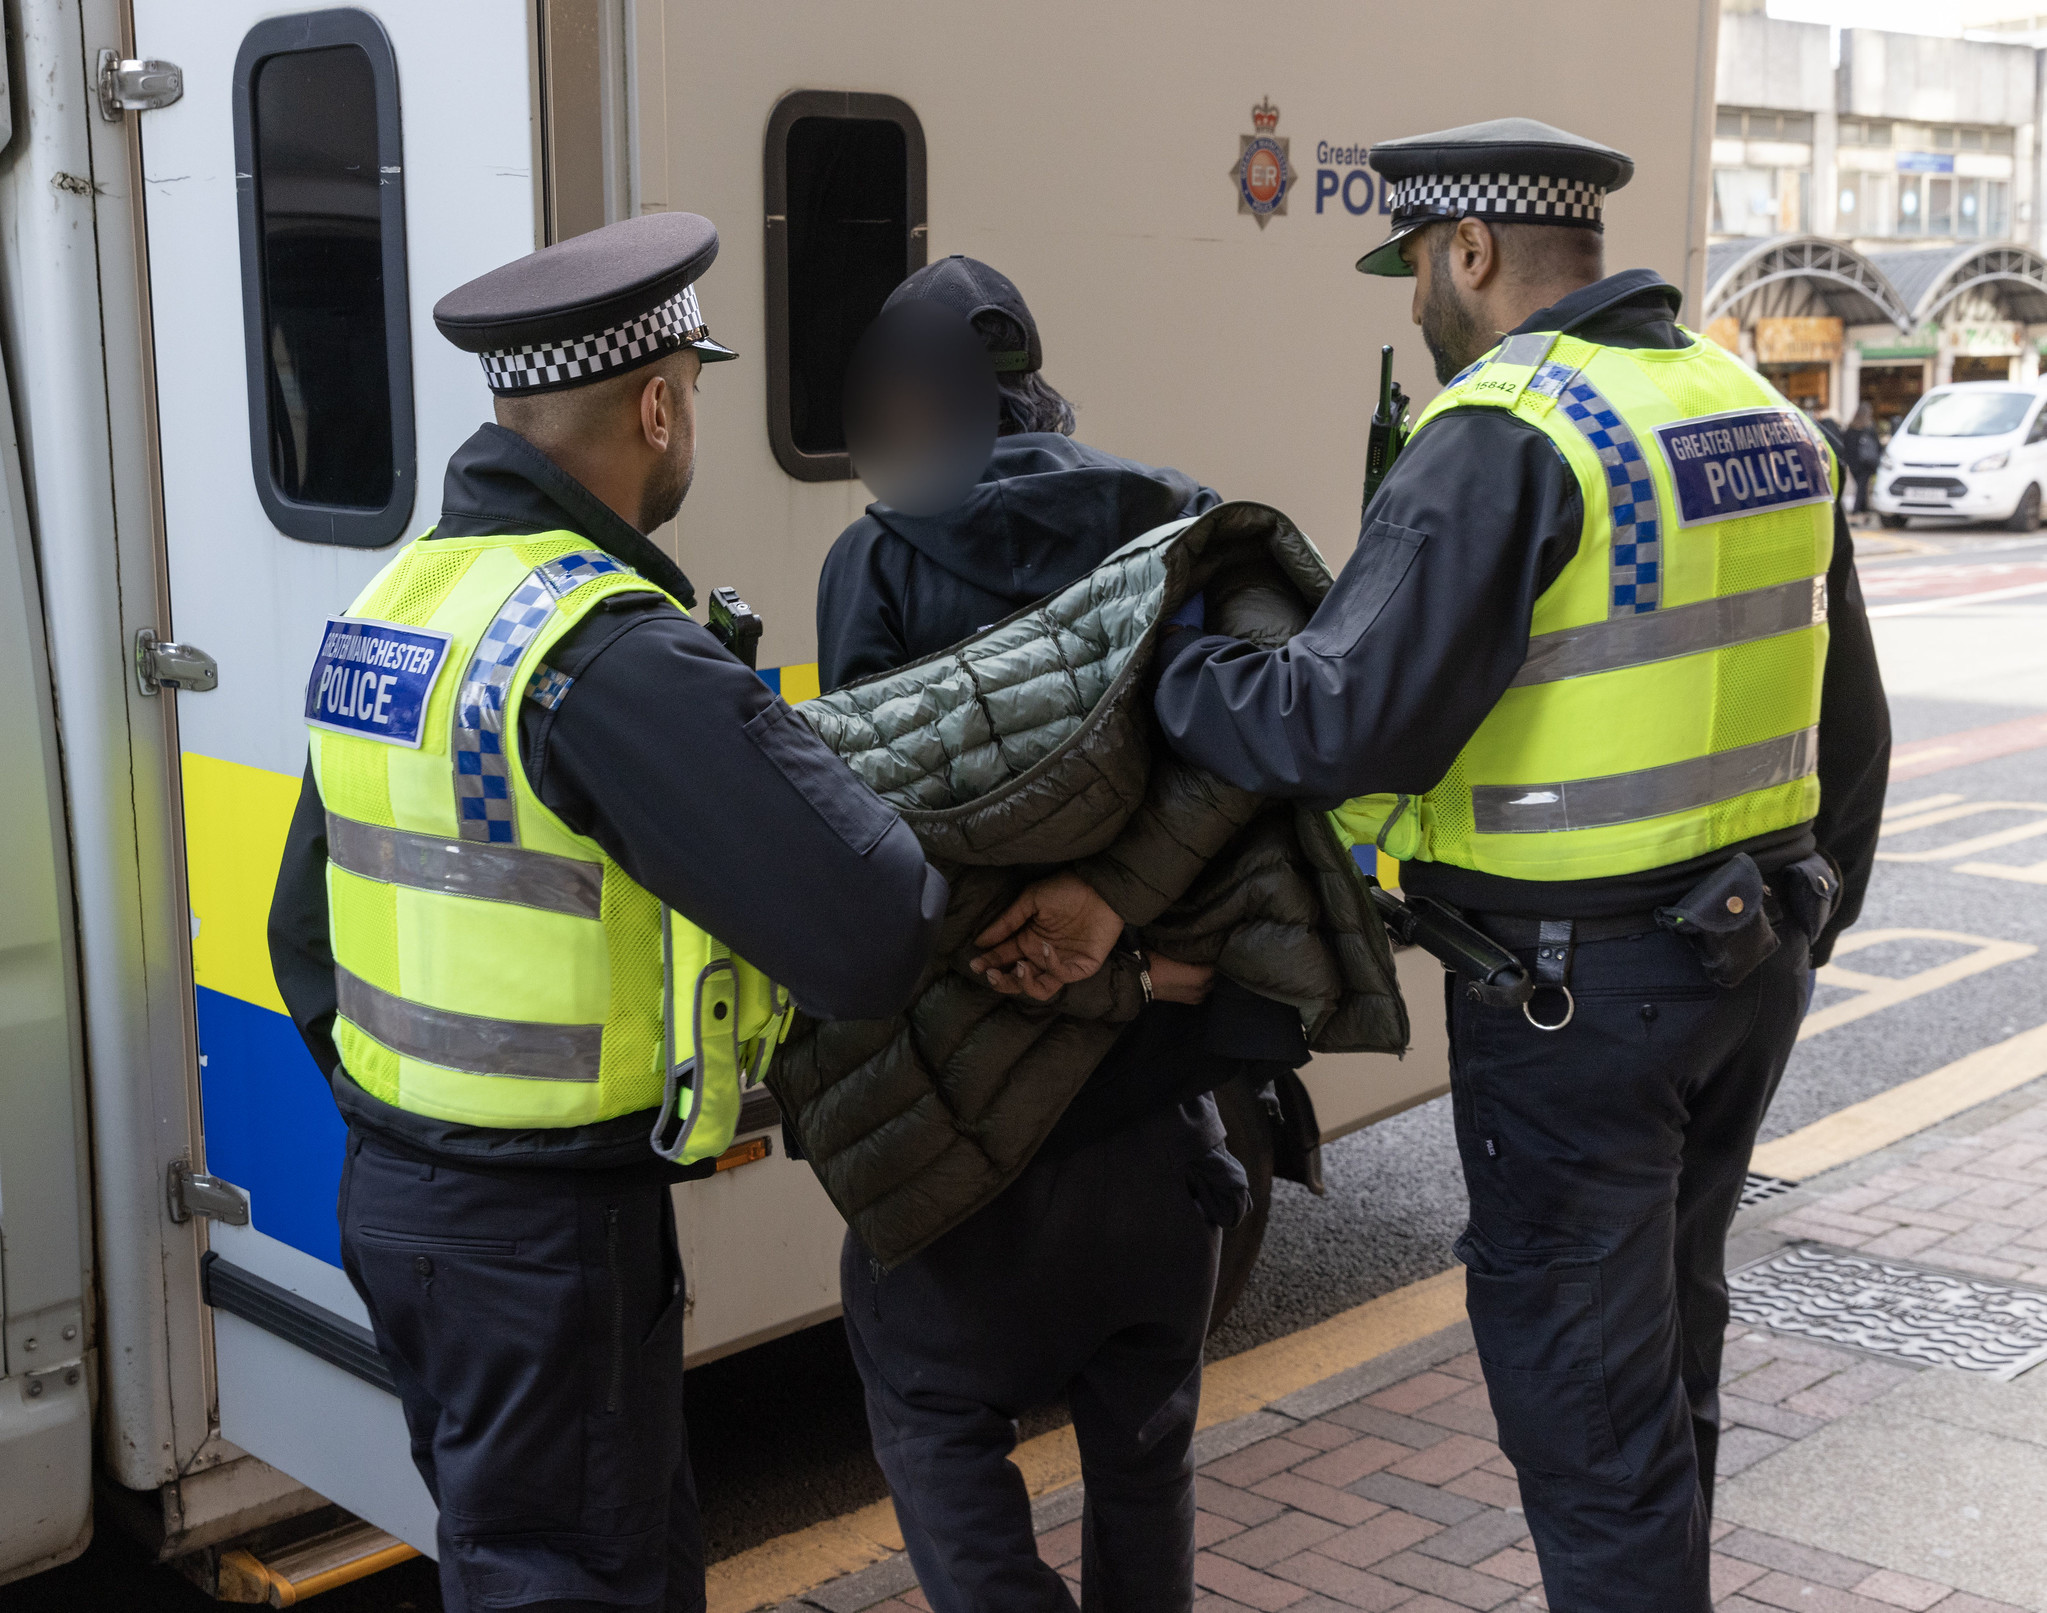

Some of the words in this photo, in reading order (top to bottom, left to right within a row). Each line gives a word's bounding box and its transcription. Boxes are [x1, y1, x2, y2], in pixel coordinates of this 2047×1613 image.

[1317, 141, 1368, 165] Greate
[1315, 169, 1393, 216] POL
[1475, 381, 1516, 394] 15842
[1671, 429, 1734, 461] GREATER
[1732, 421, 1804, 451] MANCHESTE
[1704, 449, 1809, 504] POLICE
[346, 635, 435, 675] MANCHESTER
[317, 664, 398, 724] POLICE
